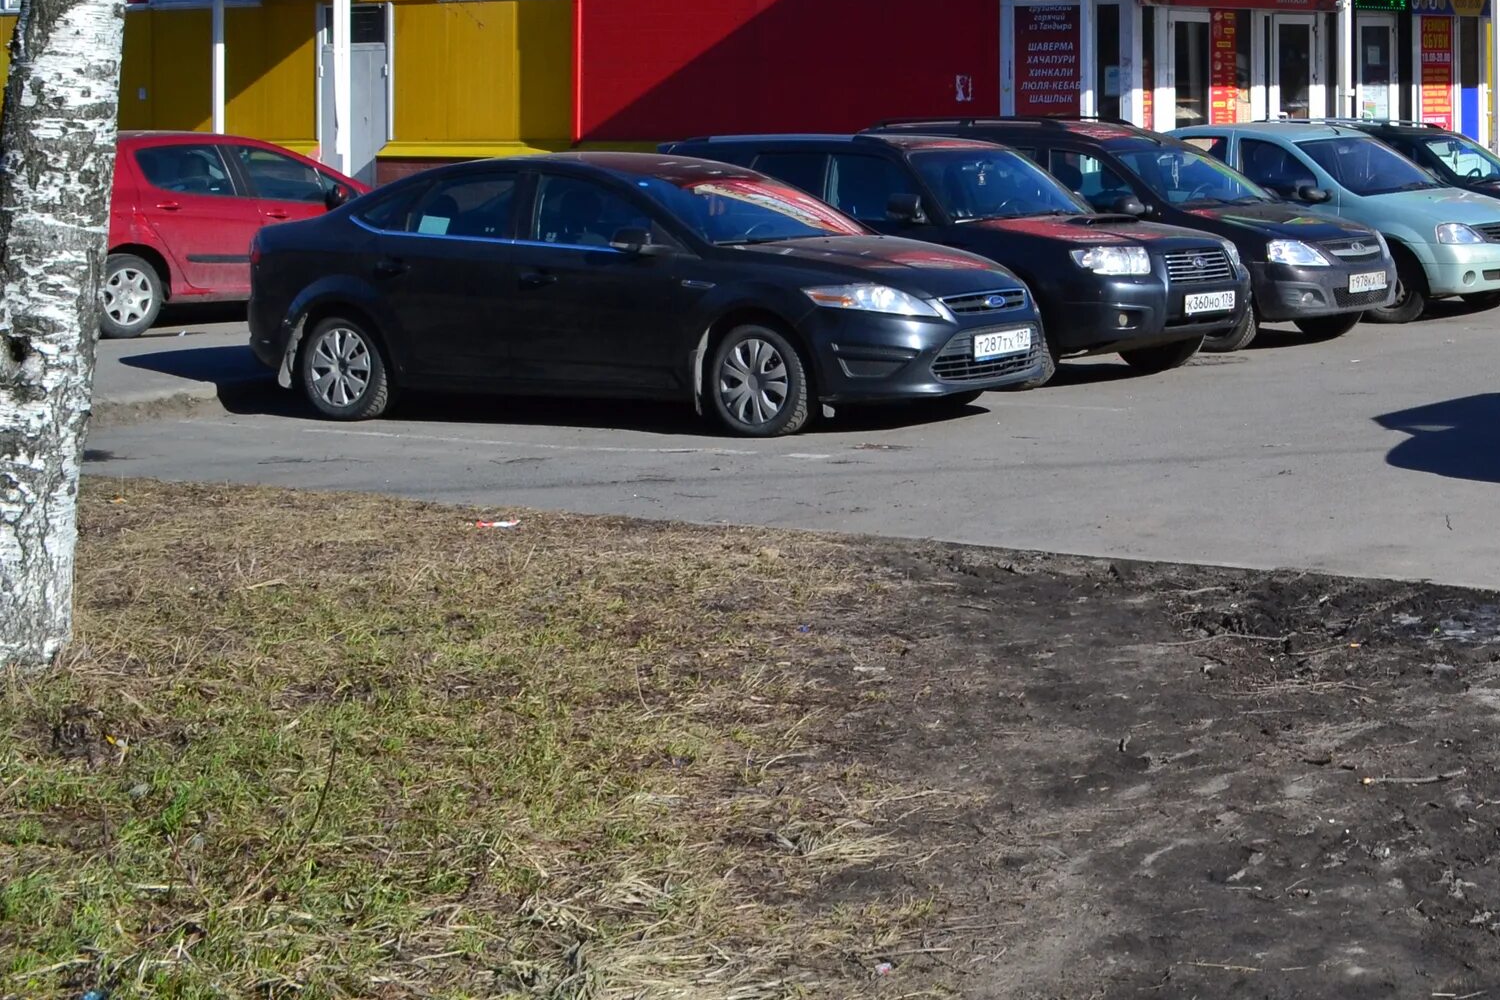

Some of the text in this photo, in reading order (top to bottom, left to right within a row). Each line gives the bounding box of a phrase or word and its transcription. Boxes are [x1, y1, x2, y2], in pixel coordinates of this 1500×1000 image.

[1039, 22, 1072, 31] Тандыра
[1028, 41, 1074, 51] ШАВЕРМА
[1423, 33, 1449, 49] ОБУВИ
[1026, 55, 1076, 64] ХАЧАПУРИ
[1028, 68, 1073, 77] ХИНКАЛИ
[1021, 80, 1081, 91] ЛЮЛЯ-КЕБАБ
[1029, 95, 1073, 104] ШАШЛЫК
[1187, 292, 1234, 311] К360НО 178
[978, 330, 1029, 354] Т287ТХ 197
